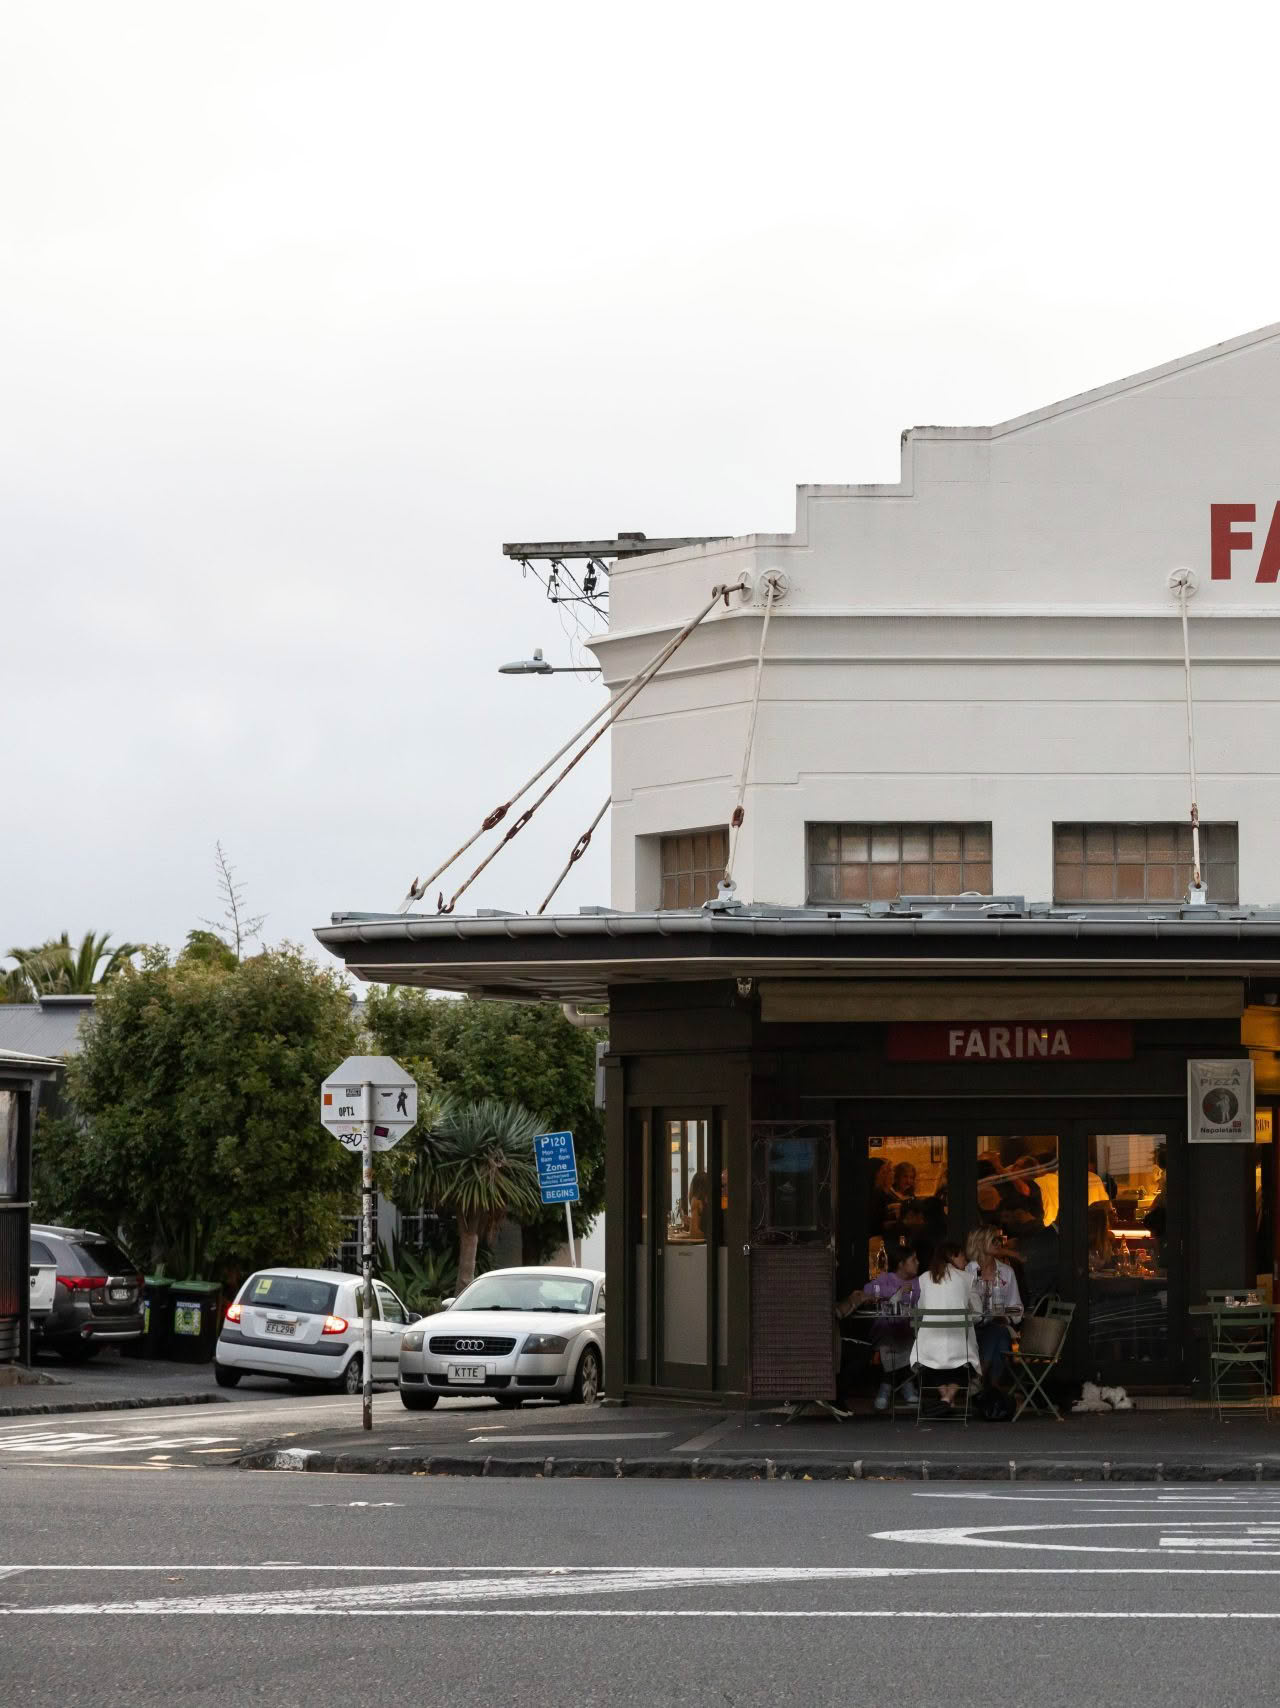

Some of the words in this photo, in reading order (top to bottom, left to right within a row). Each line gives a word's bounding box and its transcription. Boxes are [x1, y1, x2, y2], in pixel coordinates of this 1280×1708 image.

[948, 1026, 1072, 1059] FARINA
[1200, 1077, 1241, 1087] PIZZA
[541, 1136, 566, 1149] P120
[545, 1163, 568, 1172] Zone
[545, 1188, 575, 1199] BEGINS
[259, 1280, 268, 1290] L
[454, 1367, 479, 1378] KTTE
